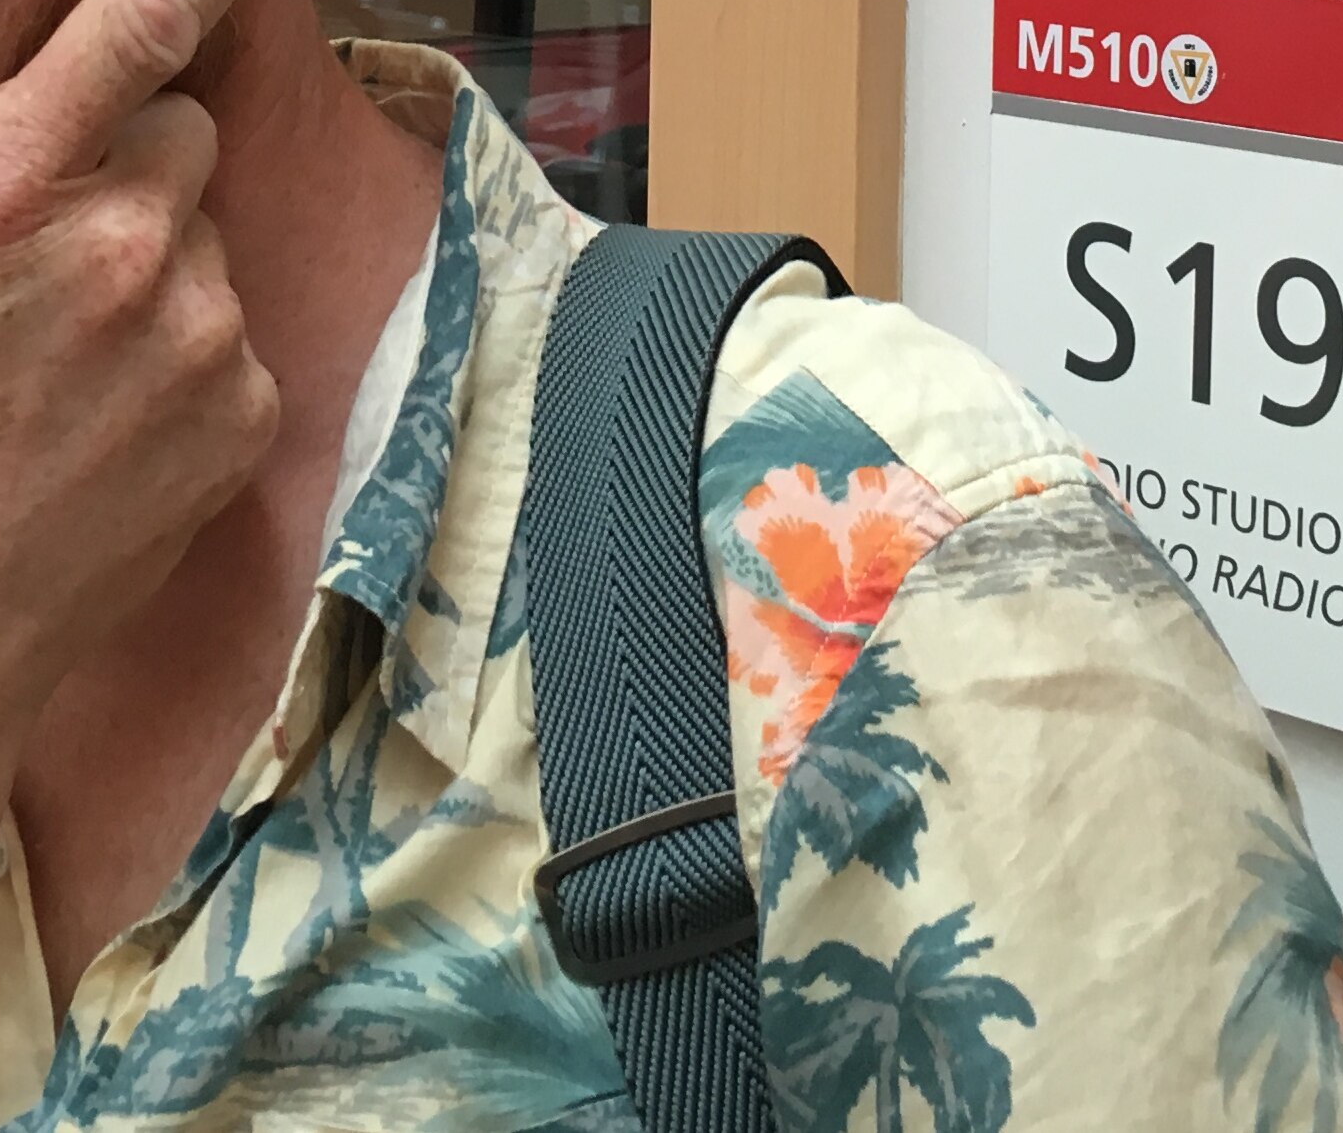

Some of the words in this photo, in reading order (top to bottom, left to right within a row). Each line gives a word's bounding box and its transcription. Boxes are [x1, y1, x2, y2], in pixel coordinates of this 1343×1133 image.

[1017, 18, 1159, 88] M510
[1181, 478, 1342, 555] STUDIO
[1159, 538, 1199, 583] O
